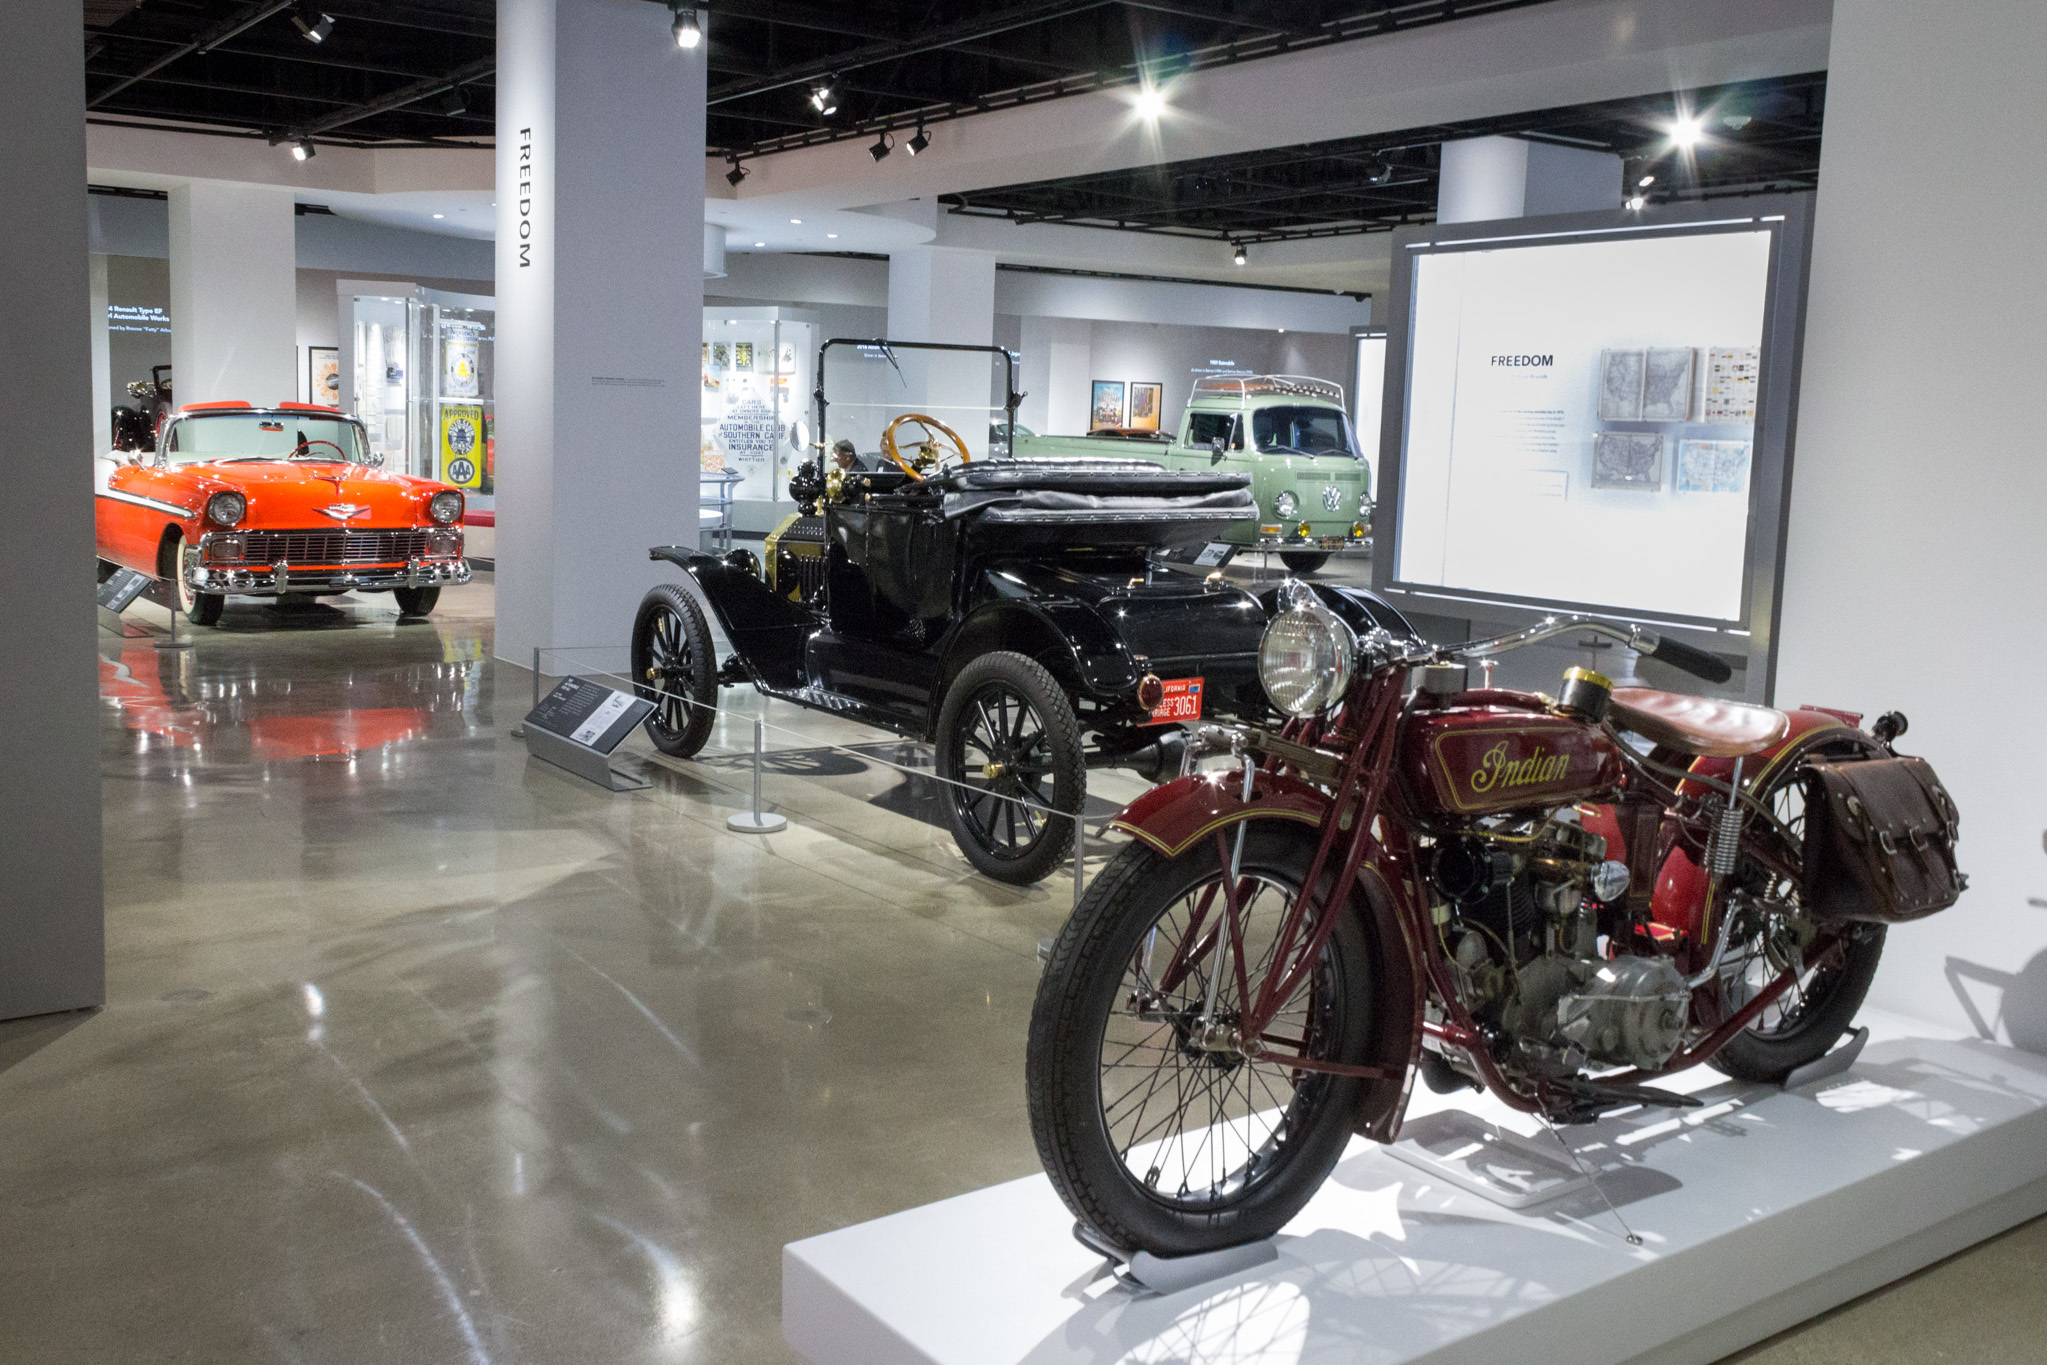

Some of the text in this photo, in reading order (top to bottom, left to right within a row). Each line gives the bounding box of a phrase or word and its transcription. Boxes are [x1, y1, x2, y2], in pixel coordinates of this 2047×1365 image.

[519, 127, 531, 268] FREEDOM
[114, 306, 138, 314] Renault
[138, 307, 153, 315] Type
[113, 313, 149, 321] Automobile
[1491, 354, 1554, 368] FREEDOM
[444, 409, 480, 420] APPROVED
[719, 423, 764, 431] AUTOMOBILE
[723, 431, 761, 439] SOUTHERN
[764, 432, 787, 440] CAIF.
[452, 461, 471, 480] AAA
[1173, 694, 1197, 717] 3061
[1471, 740, 1570, 793] Indian
